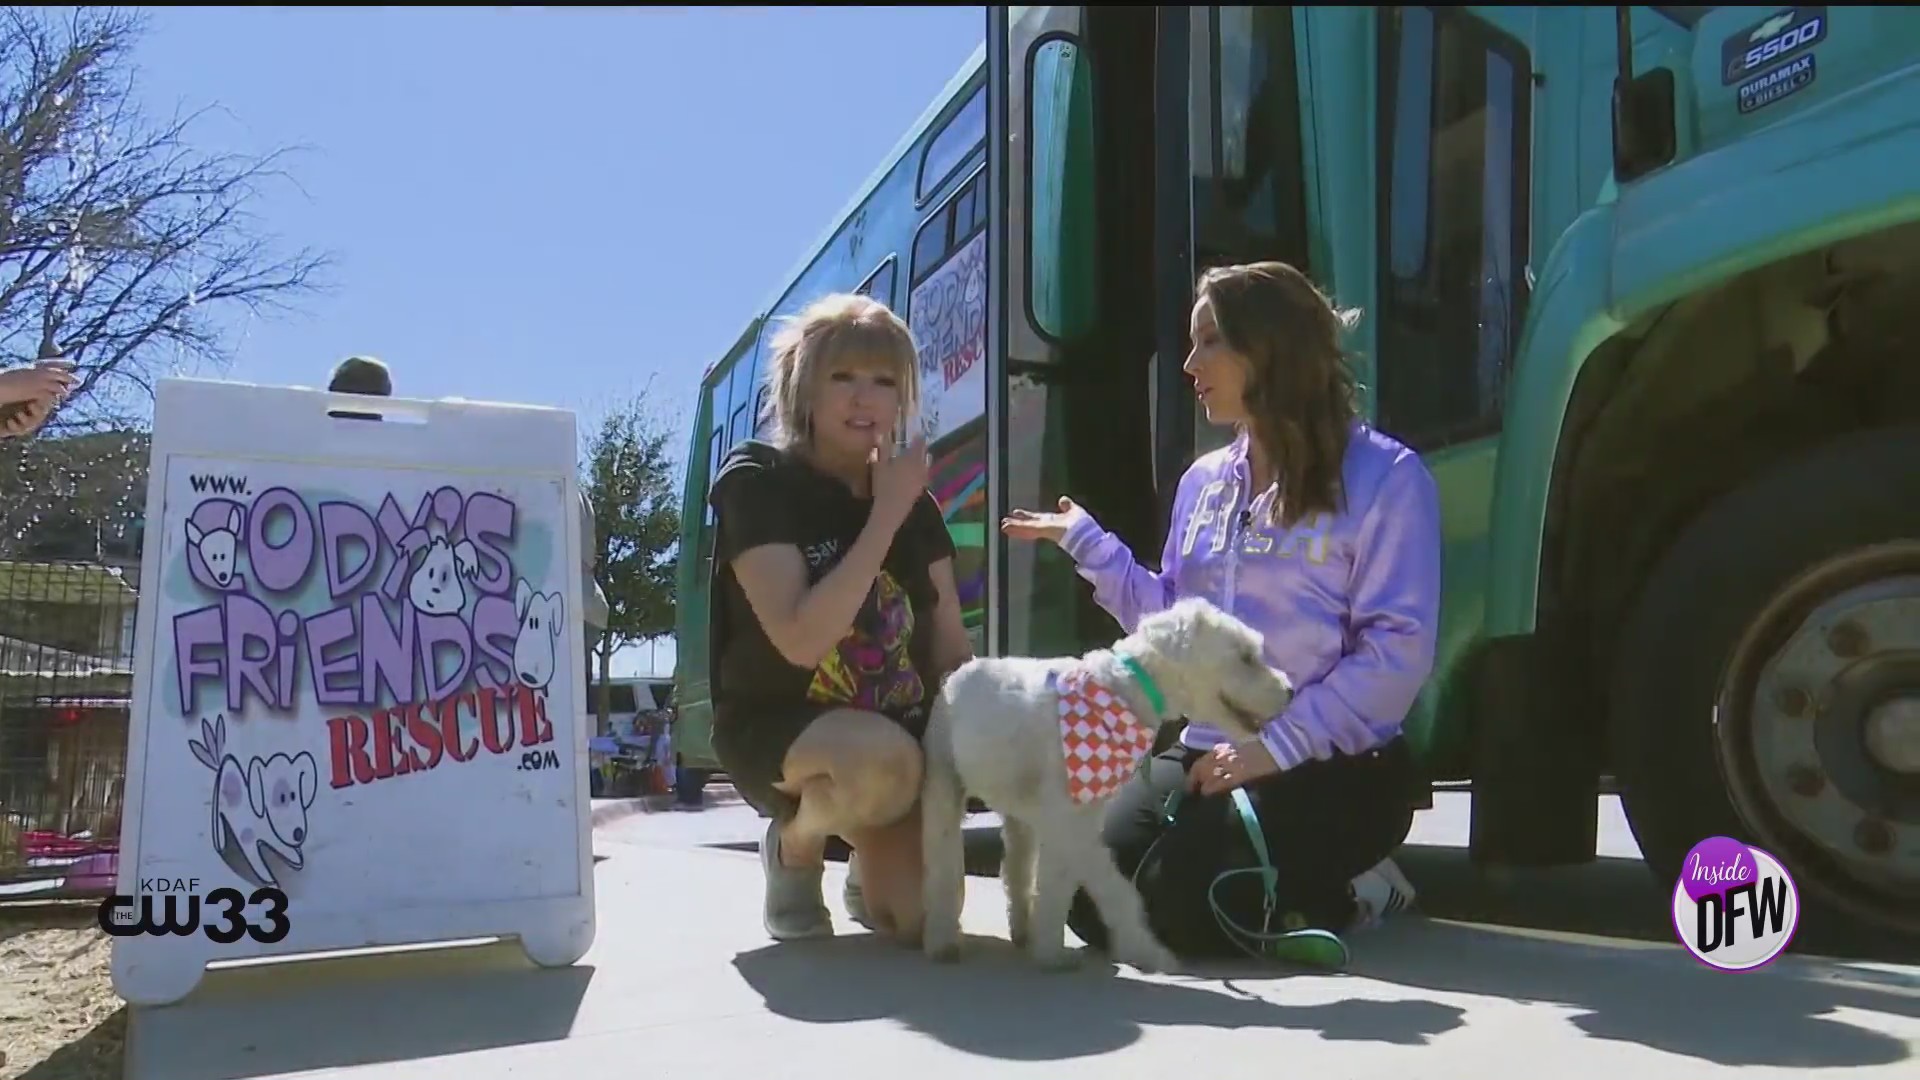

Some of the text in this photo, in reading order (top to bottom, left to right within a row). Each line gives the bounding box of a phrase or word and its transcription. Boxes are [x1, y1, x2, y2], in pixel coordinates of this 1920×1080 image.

[1741, 56, 1811, 97] DURAMAX
[1745, 19, 1820, 69] 5500
[185, 486, 515, 600] CODY'S
[326, 681, 554, 790] RESCUE
